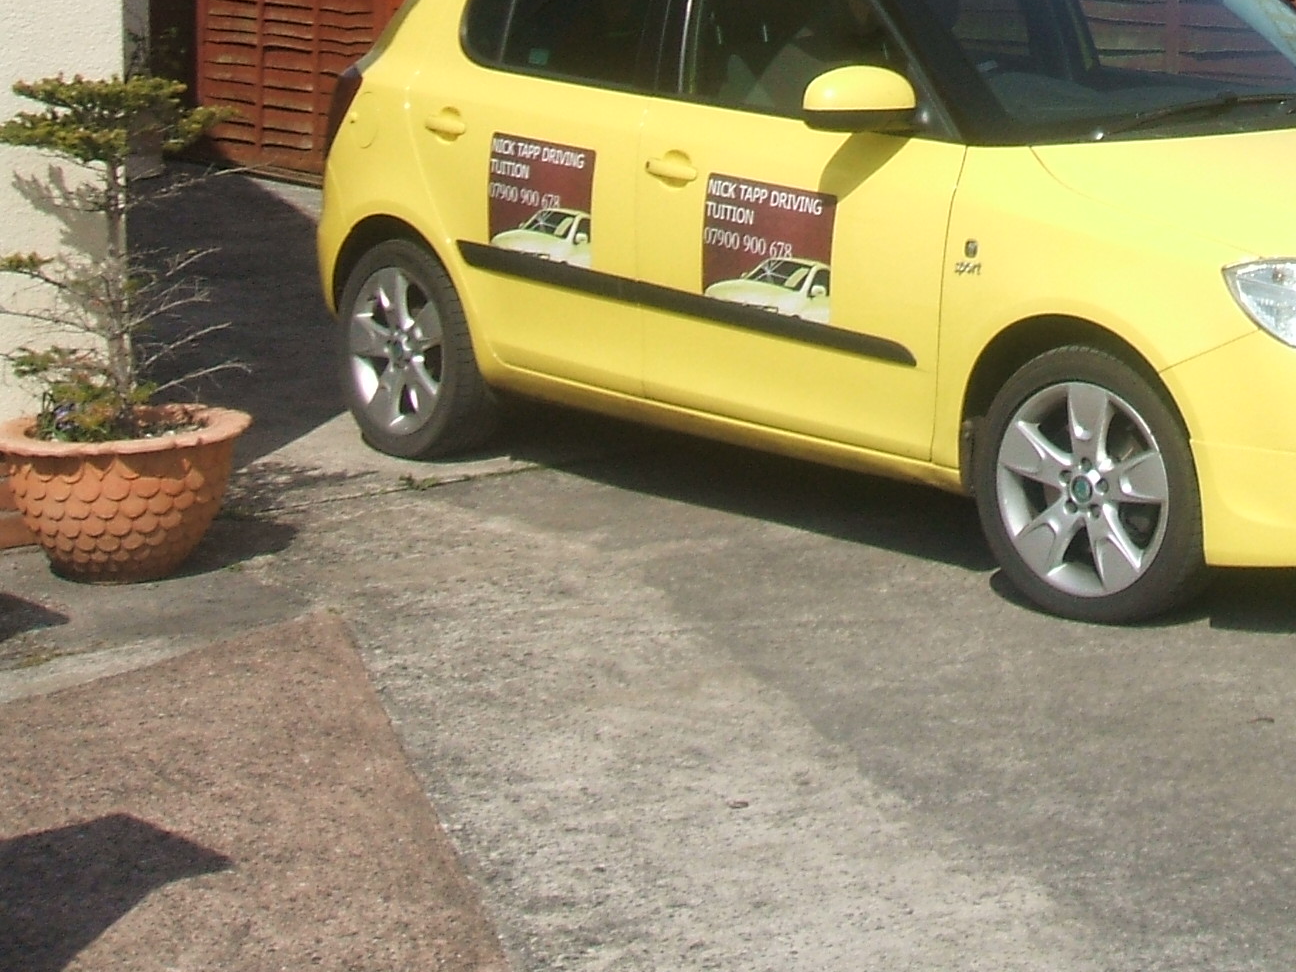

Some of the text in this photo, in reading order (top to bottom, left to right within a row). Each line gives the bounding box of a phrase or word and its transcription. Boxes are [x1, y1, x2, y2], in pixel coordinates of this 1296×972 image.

[493, 138, 585, 169] NICK TAPP DRIVING
[490, 158, 530, 179] TUITION
[520, 188, 540, 207] 900
[541, 193, 561, 209] 678
[708, 179, 822, 215] NICK TAPP DRIVING
[706, 201, 755, 225] TUITION
[704, 227, 793, 259] 07900 900 678
